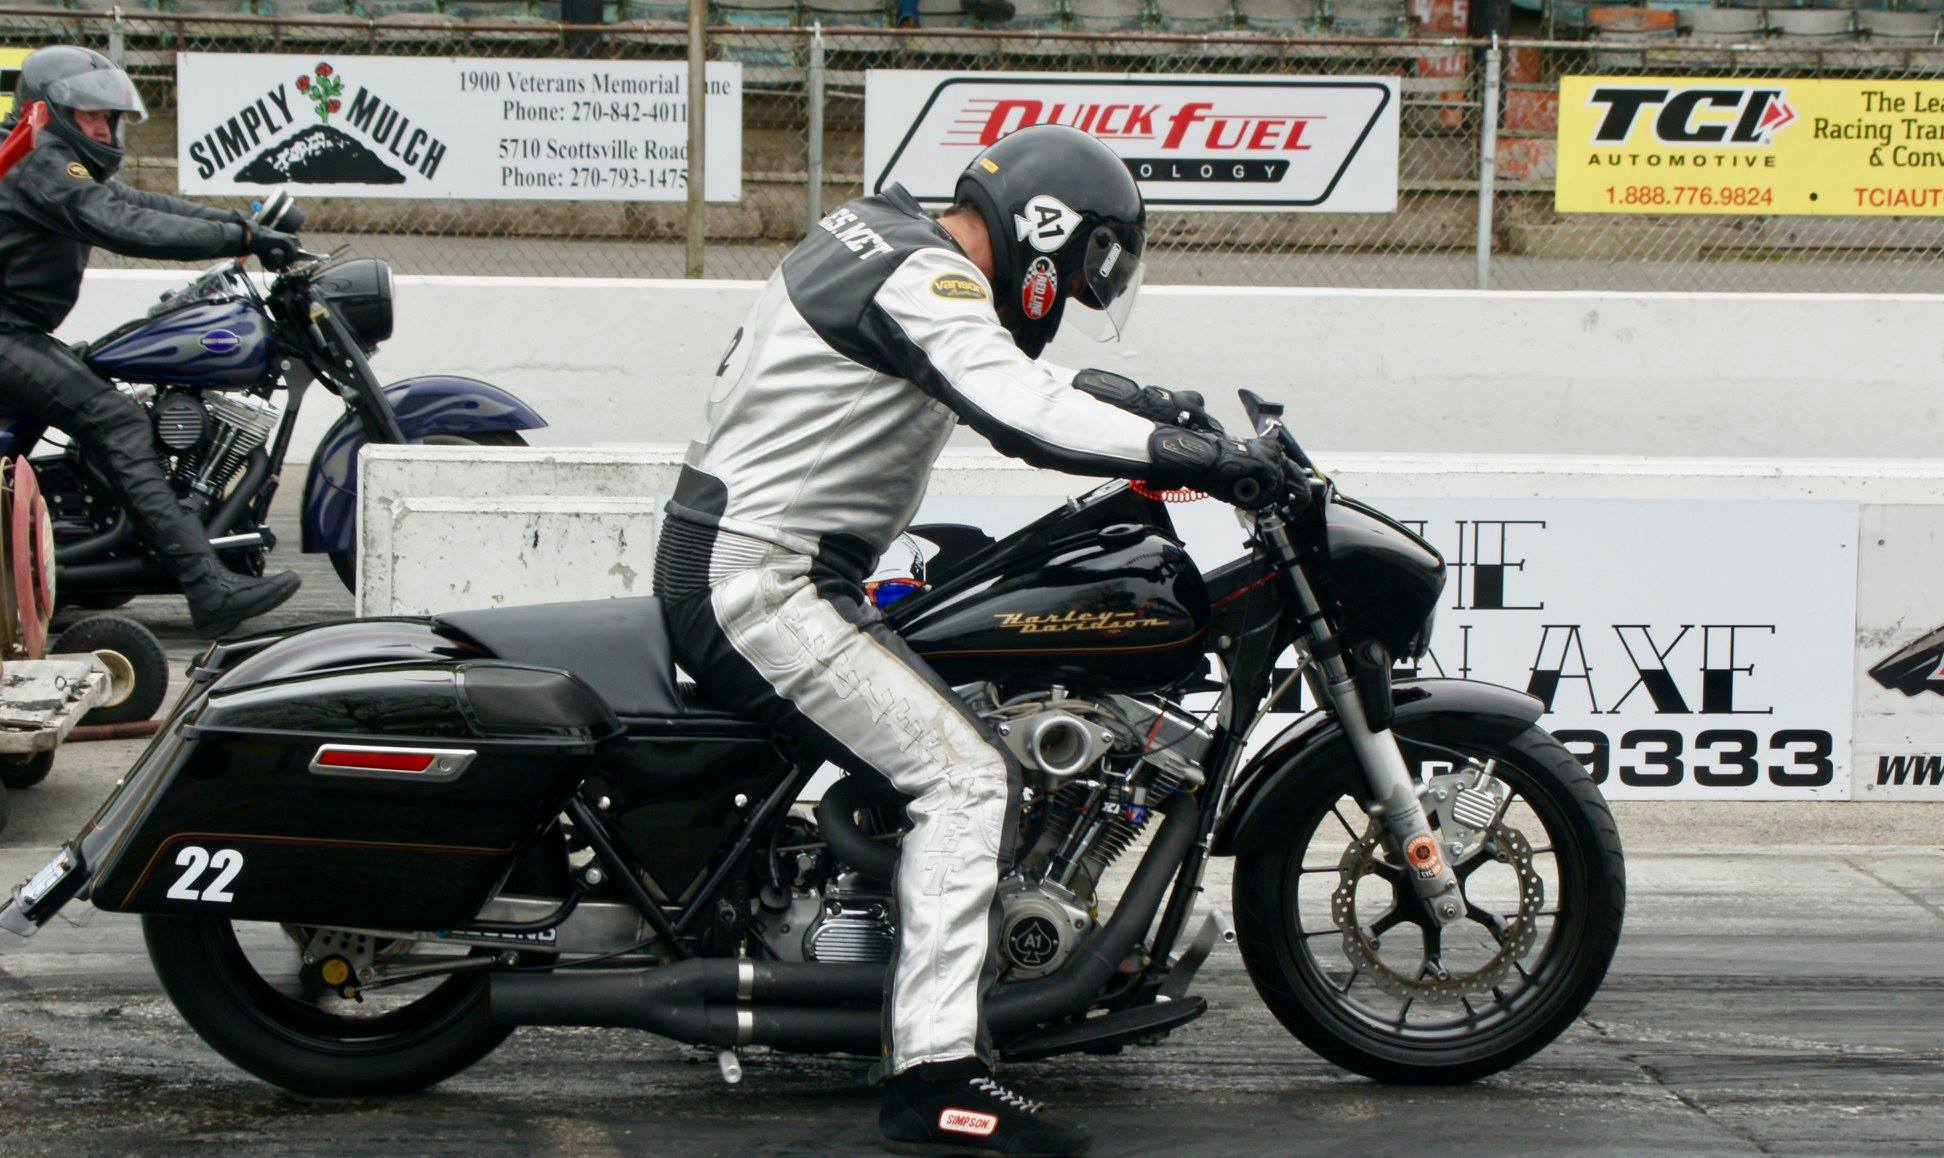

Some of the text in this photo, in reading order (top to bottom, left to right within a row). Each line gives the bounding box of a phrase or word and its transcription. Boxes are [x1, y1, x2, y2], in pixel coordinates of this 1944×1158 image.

[460, 71, 500, 92] 1900
[507, 72, 586, 93] Veterans
[592, 73, 679, 95] Memorial
[503, 100, 688, 122] Phone: 270-842-4011
[1861, 91, 1906, 113] The
[1591, 88, 1781, 143] TCI
[189, 83, 293, 180] SIMPLY
[346, 86, 447, 180] MULCH
[1814, 118, 1893, 146] Racing
[499, 138, 540, 159] 5710
[547, 139, 638, 159] Scottsville
[1869, 147, 1884, 167] &
[1140, 164, 1276, 179] OLOGY
[1588, 154, 1776, 168] AUTOMOTIVE
[501, 166, 689, 188] Phone: 270-793-1475
[1606, 186, 1773, 206] 1.888.776.9824
[1854, 187, 1944, 208] TCIAUT
[1034, 205, 1065, 239] A1
[1526, 624, 1776, 715] AXE
[166, 845, 244, 903] 22
[1023, 933, 1042, 948] A1
[946, 1114, 990, 1129] SIMPSON
